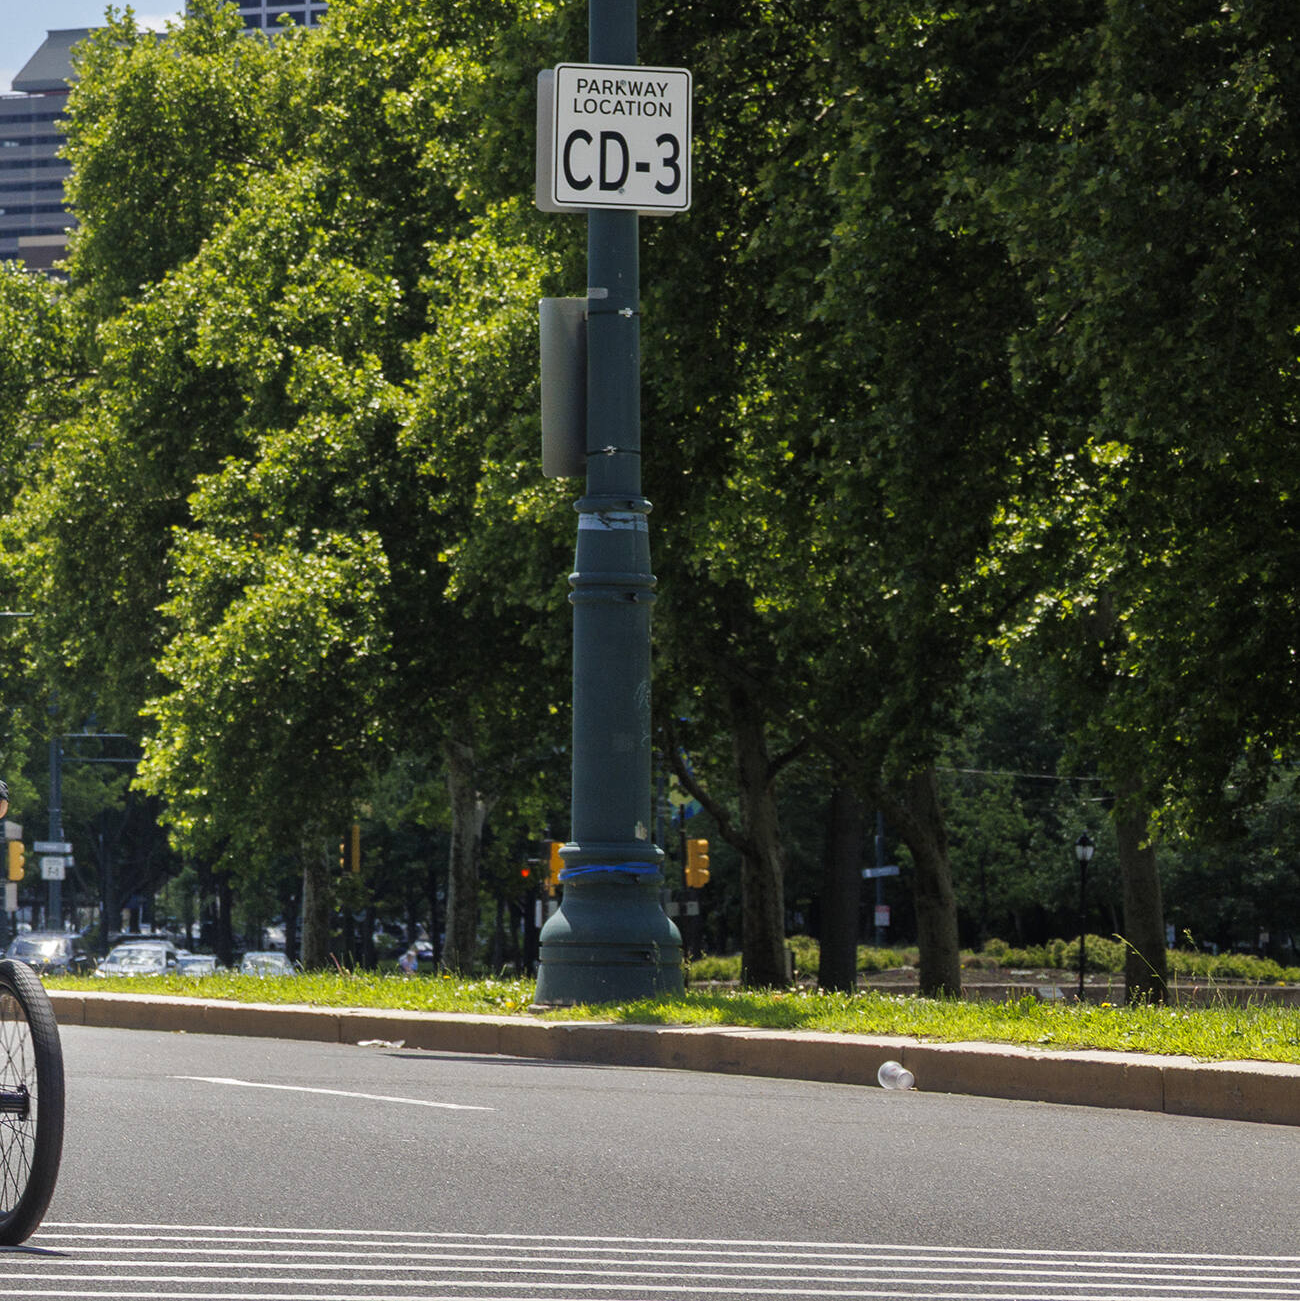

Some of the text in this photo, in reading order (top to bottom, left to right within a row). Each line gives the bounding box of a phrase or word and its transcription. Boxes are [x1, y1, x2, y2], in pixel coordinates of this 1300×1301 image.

[577, 78, 669, 98] PARKWAY
[573, 98, 672, 117] LOCATION
[563, 129, 681, 195] CD-3
